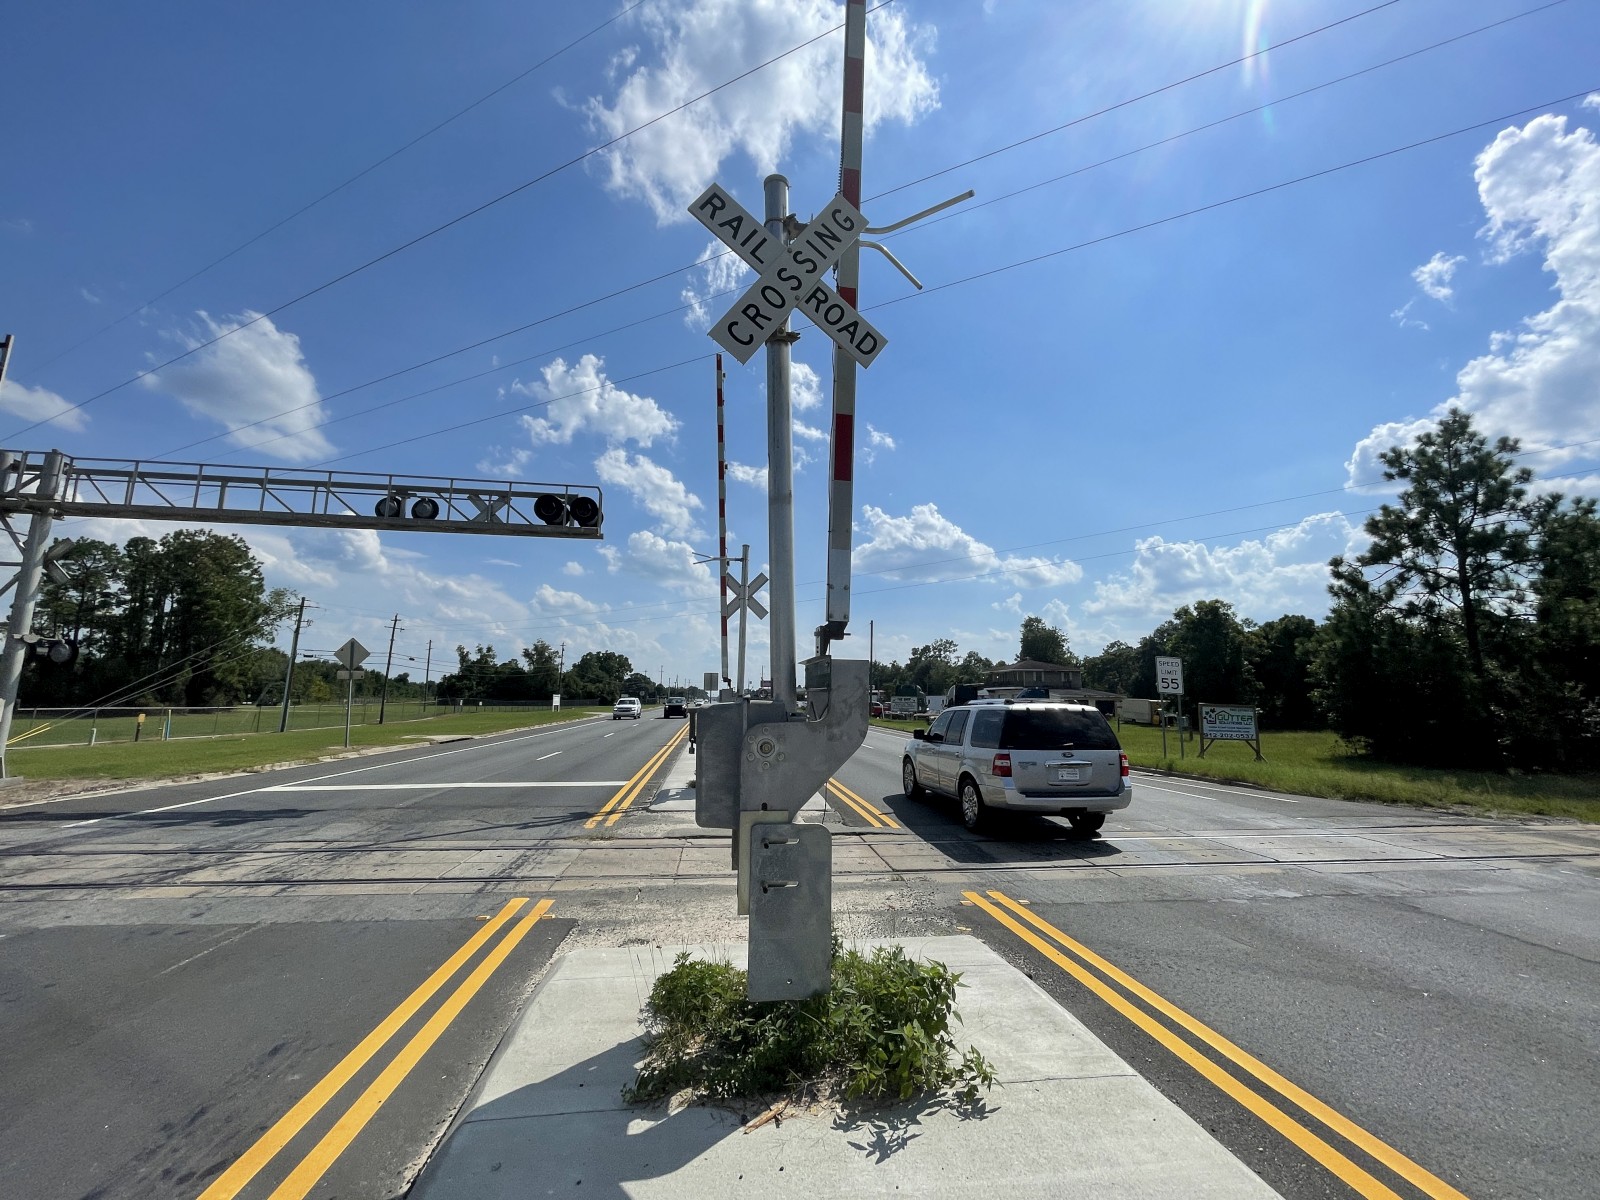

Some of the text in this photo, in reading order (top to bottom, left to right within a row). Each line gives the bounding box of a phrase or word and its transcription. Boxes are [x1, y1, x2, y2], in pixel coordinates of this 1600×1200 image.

[698, 192, 768, 265] RAIL
[727, 208, 855, 346] CROSSING
[804, 286, 878, 356] ROAD
[1161, 678, 1180, 690] 55
